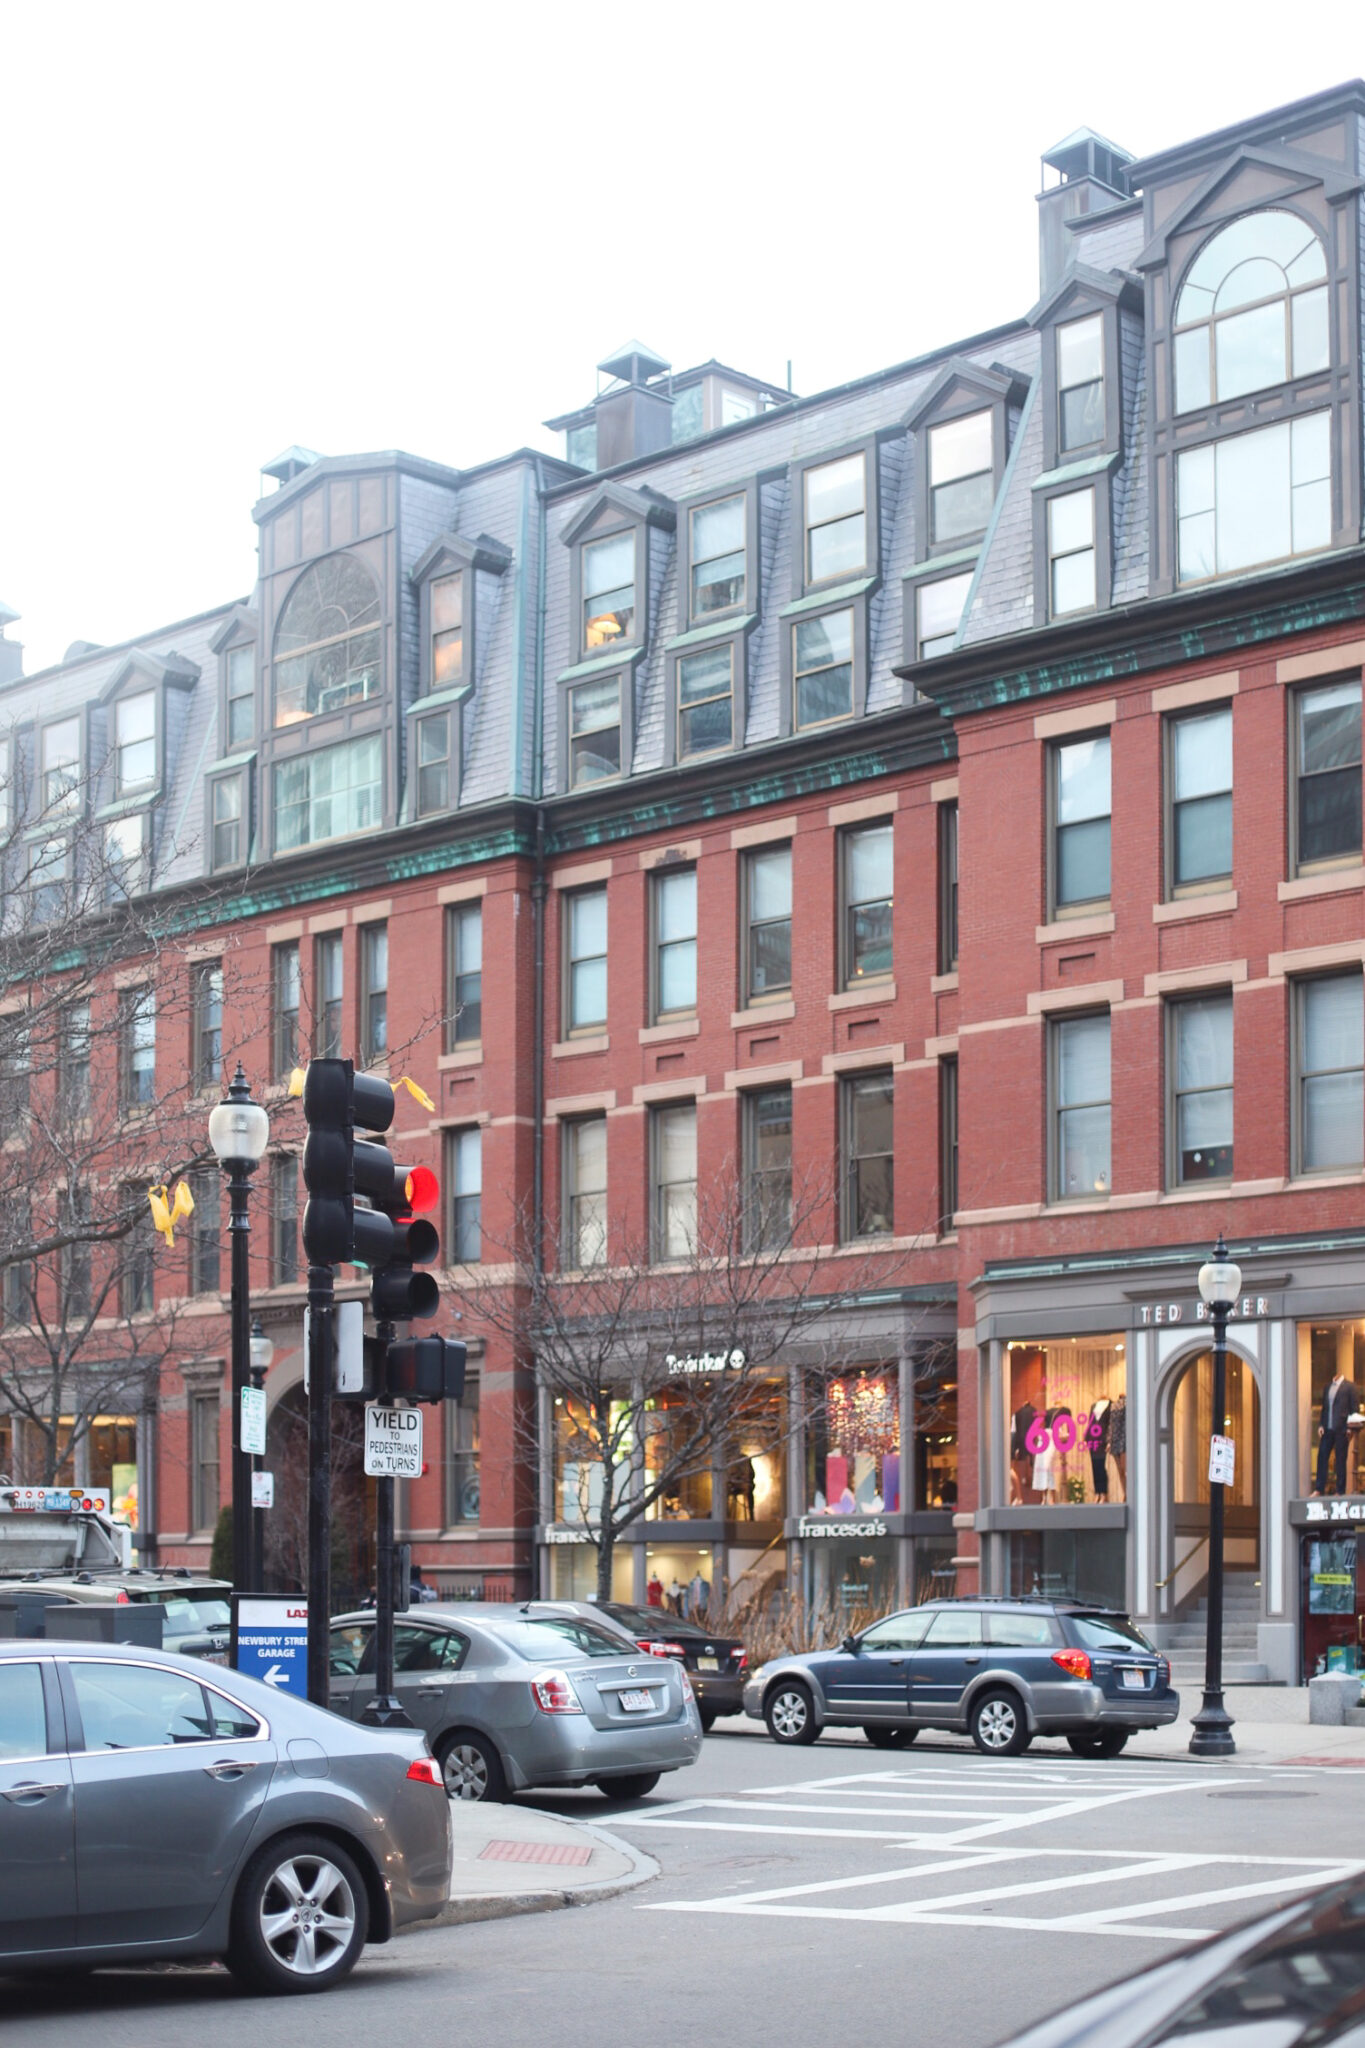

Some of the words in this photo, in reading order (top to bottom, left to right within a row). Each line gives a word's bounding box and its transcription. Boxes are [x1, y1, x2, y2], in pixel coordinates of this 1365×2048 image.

[1141, 1305, 1181, 1323] TED
[372, 1411, 417, 1430] YIELD
[390, 1431, 400, 1440] TO
[1025, 1412, 1102, 1455] 60%
[370, 1441, 417, 1456] PEDESTRIANS
[371, 1460, 383, 1468] ON
[387, 1457, 415, 1471] TURNS
[799, 1516, 887, 1537] francesca's
[238, 1636, 282, 1646] NEWBURY
[258, 1649, 295, 1657] GARAGE
